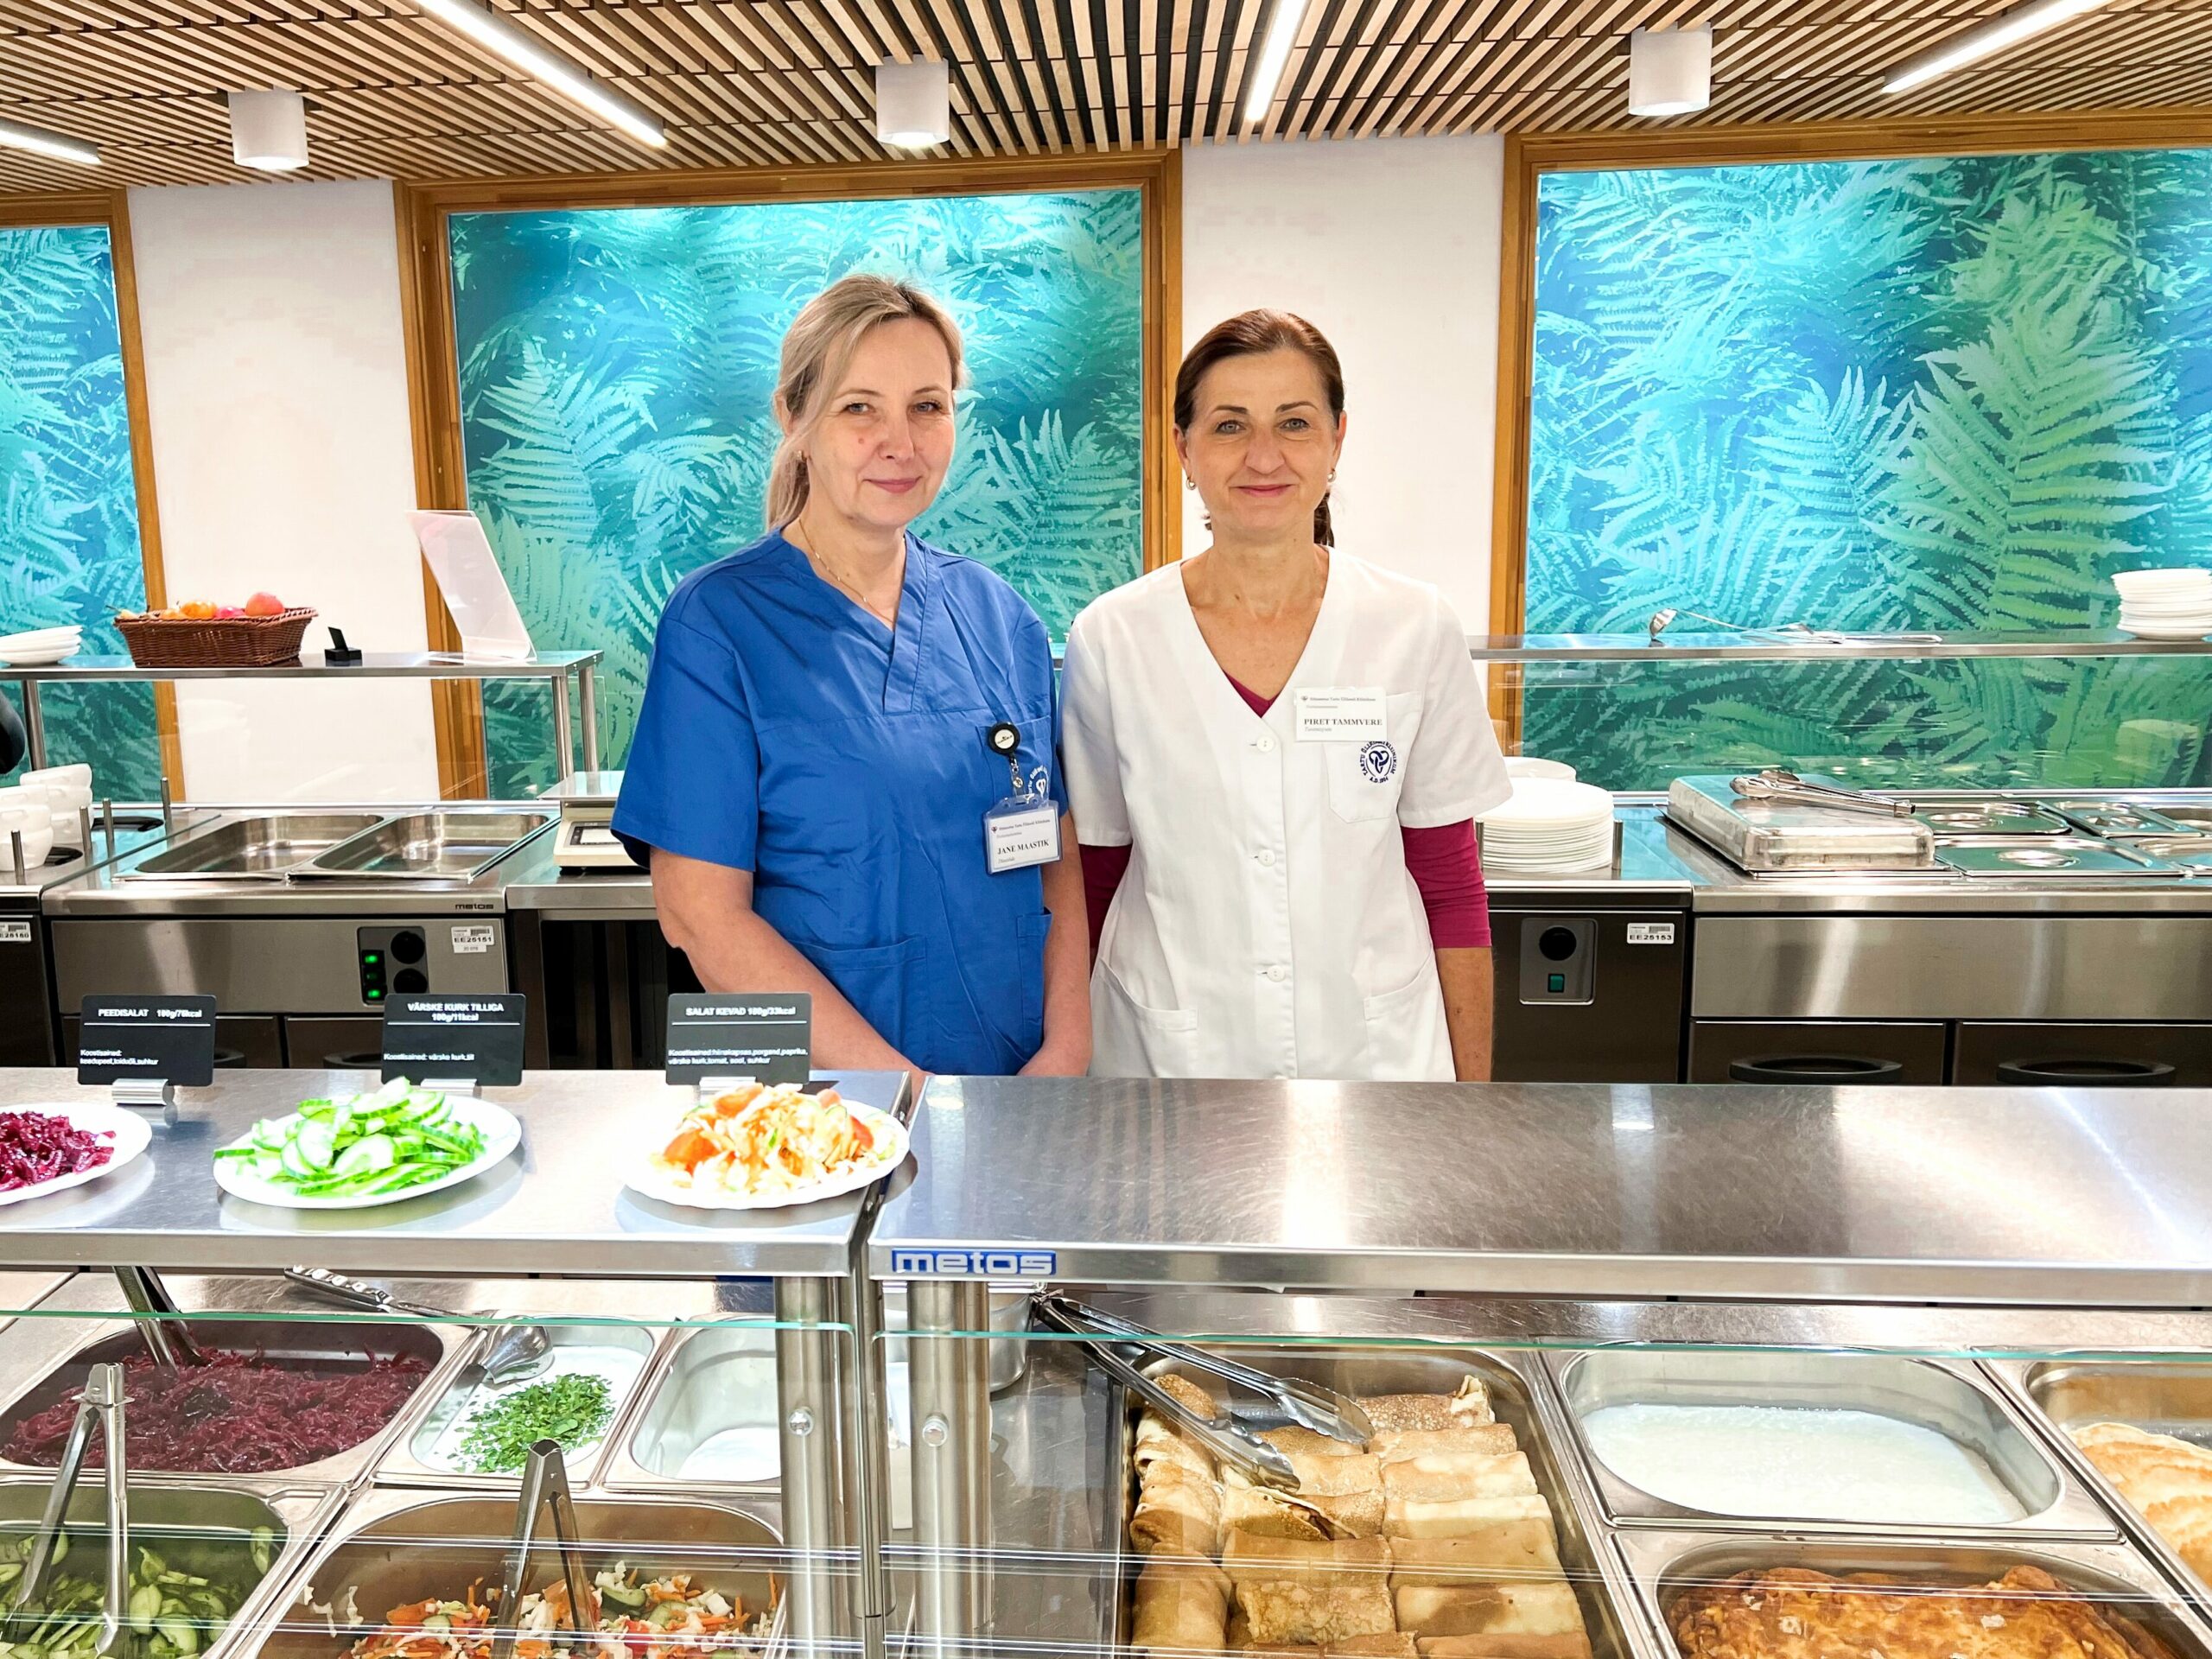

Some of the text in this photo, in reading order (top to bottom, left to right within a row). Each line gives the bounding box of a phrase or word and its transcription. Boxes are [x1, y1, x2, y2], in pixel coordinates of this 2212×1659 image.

[997, 839, 1050, 855] JANE MAASTIK
[407, 1001, 505, 1012] VÄRSKE KURK TILLIGA
[685, 1007, 715, 1016] SALAT
[715, 1007, 747, 1015] KEVAD
[98, 1008, 149, 1017] PEEDISALAT
[895, 1250, 1052, 1275] metos
